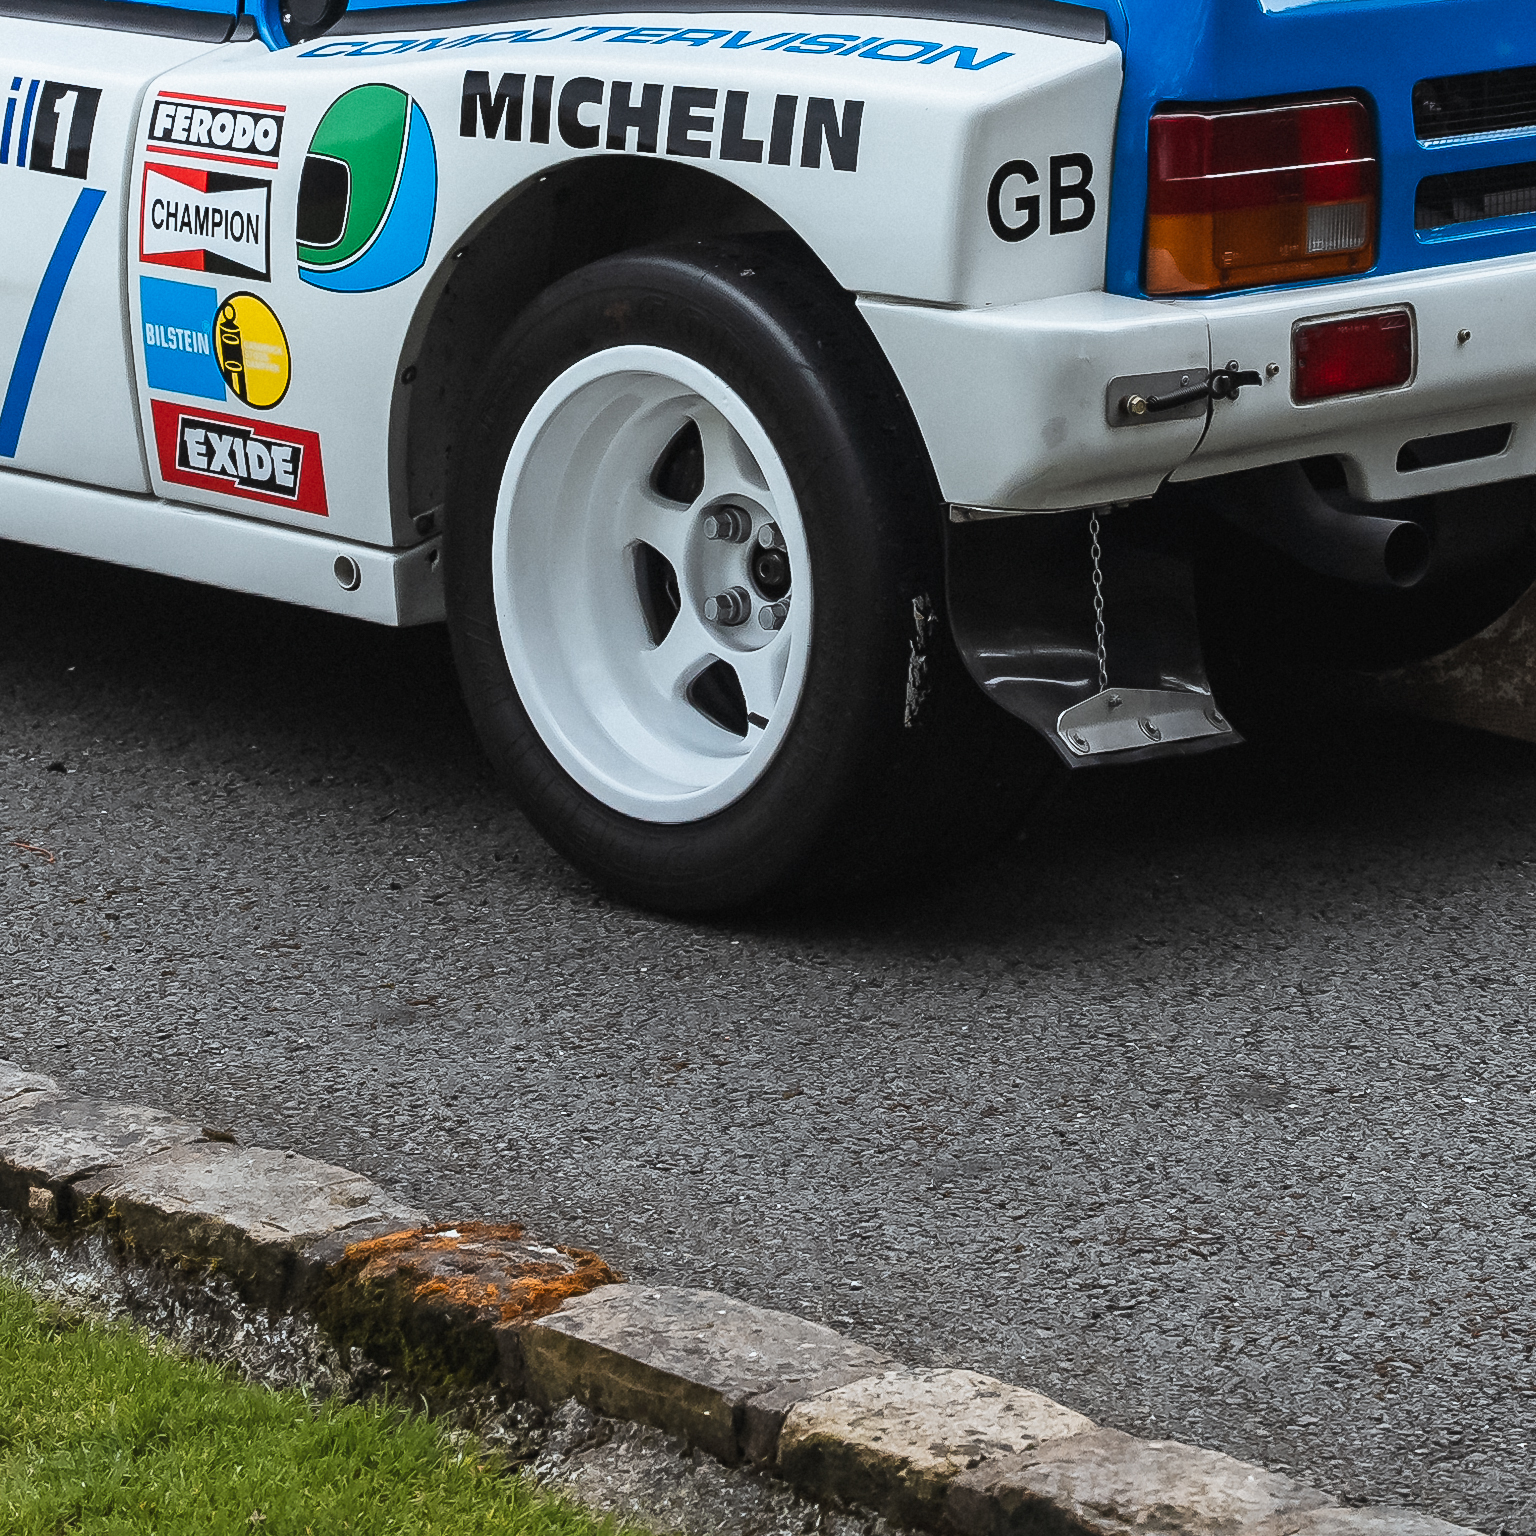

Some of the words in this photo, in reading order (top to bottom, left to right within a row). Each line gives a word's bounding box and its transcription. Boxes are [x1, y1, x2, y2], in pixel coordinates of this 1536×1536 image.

[296, 25, 1016, 71] COMPUTERVISION
[50, 88, 80, 170] 1
[154, 102, 278, 153] FERODO
[459, 68, 865, 173] MICHELIN
[150, 199, 261, 244] CHAMPION
[986, 151, 1097, 243] GB
[145, 322, 210, 356] BILSTEIN
[185, 427, 296, 488] EXIDE
